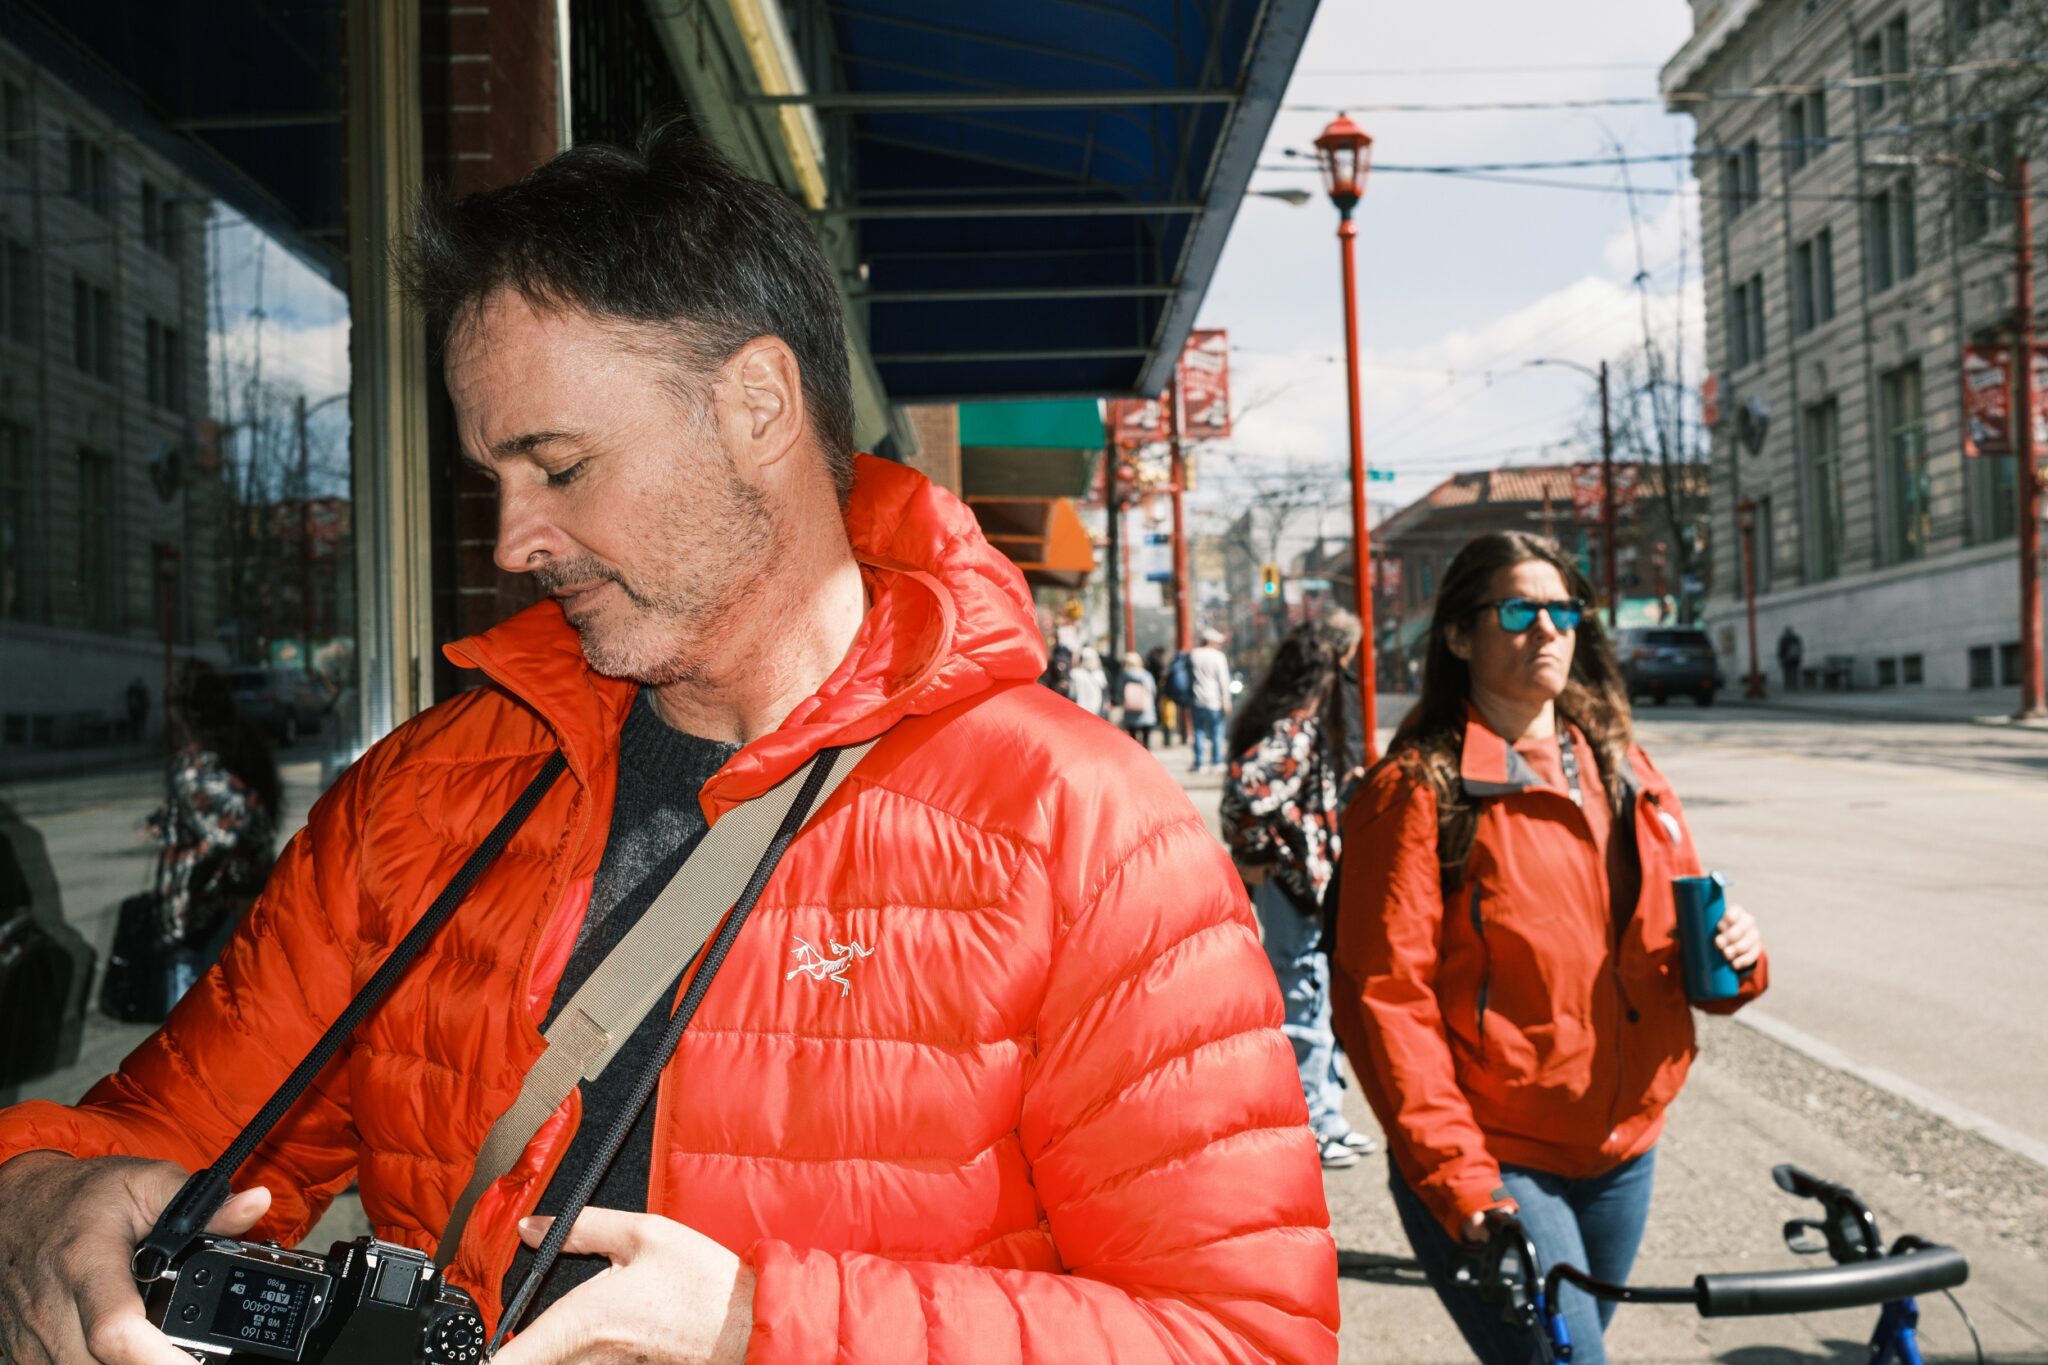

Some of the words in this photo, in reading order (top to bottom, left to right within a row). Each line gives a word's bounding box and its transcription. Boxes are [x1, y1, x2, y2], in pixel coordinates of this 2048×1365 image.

[341, 1262, 351, 1278] MODE
[242, 1299, 271, 1313] 6400
[267, 1318, 281, 1328] WB
[241, 1326, 261, 1339] 160
[441, 1342, 449, 1350] M
